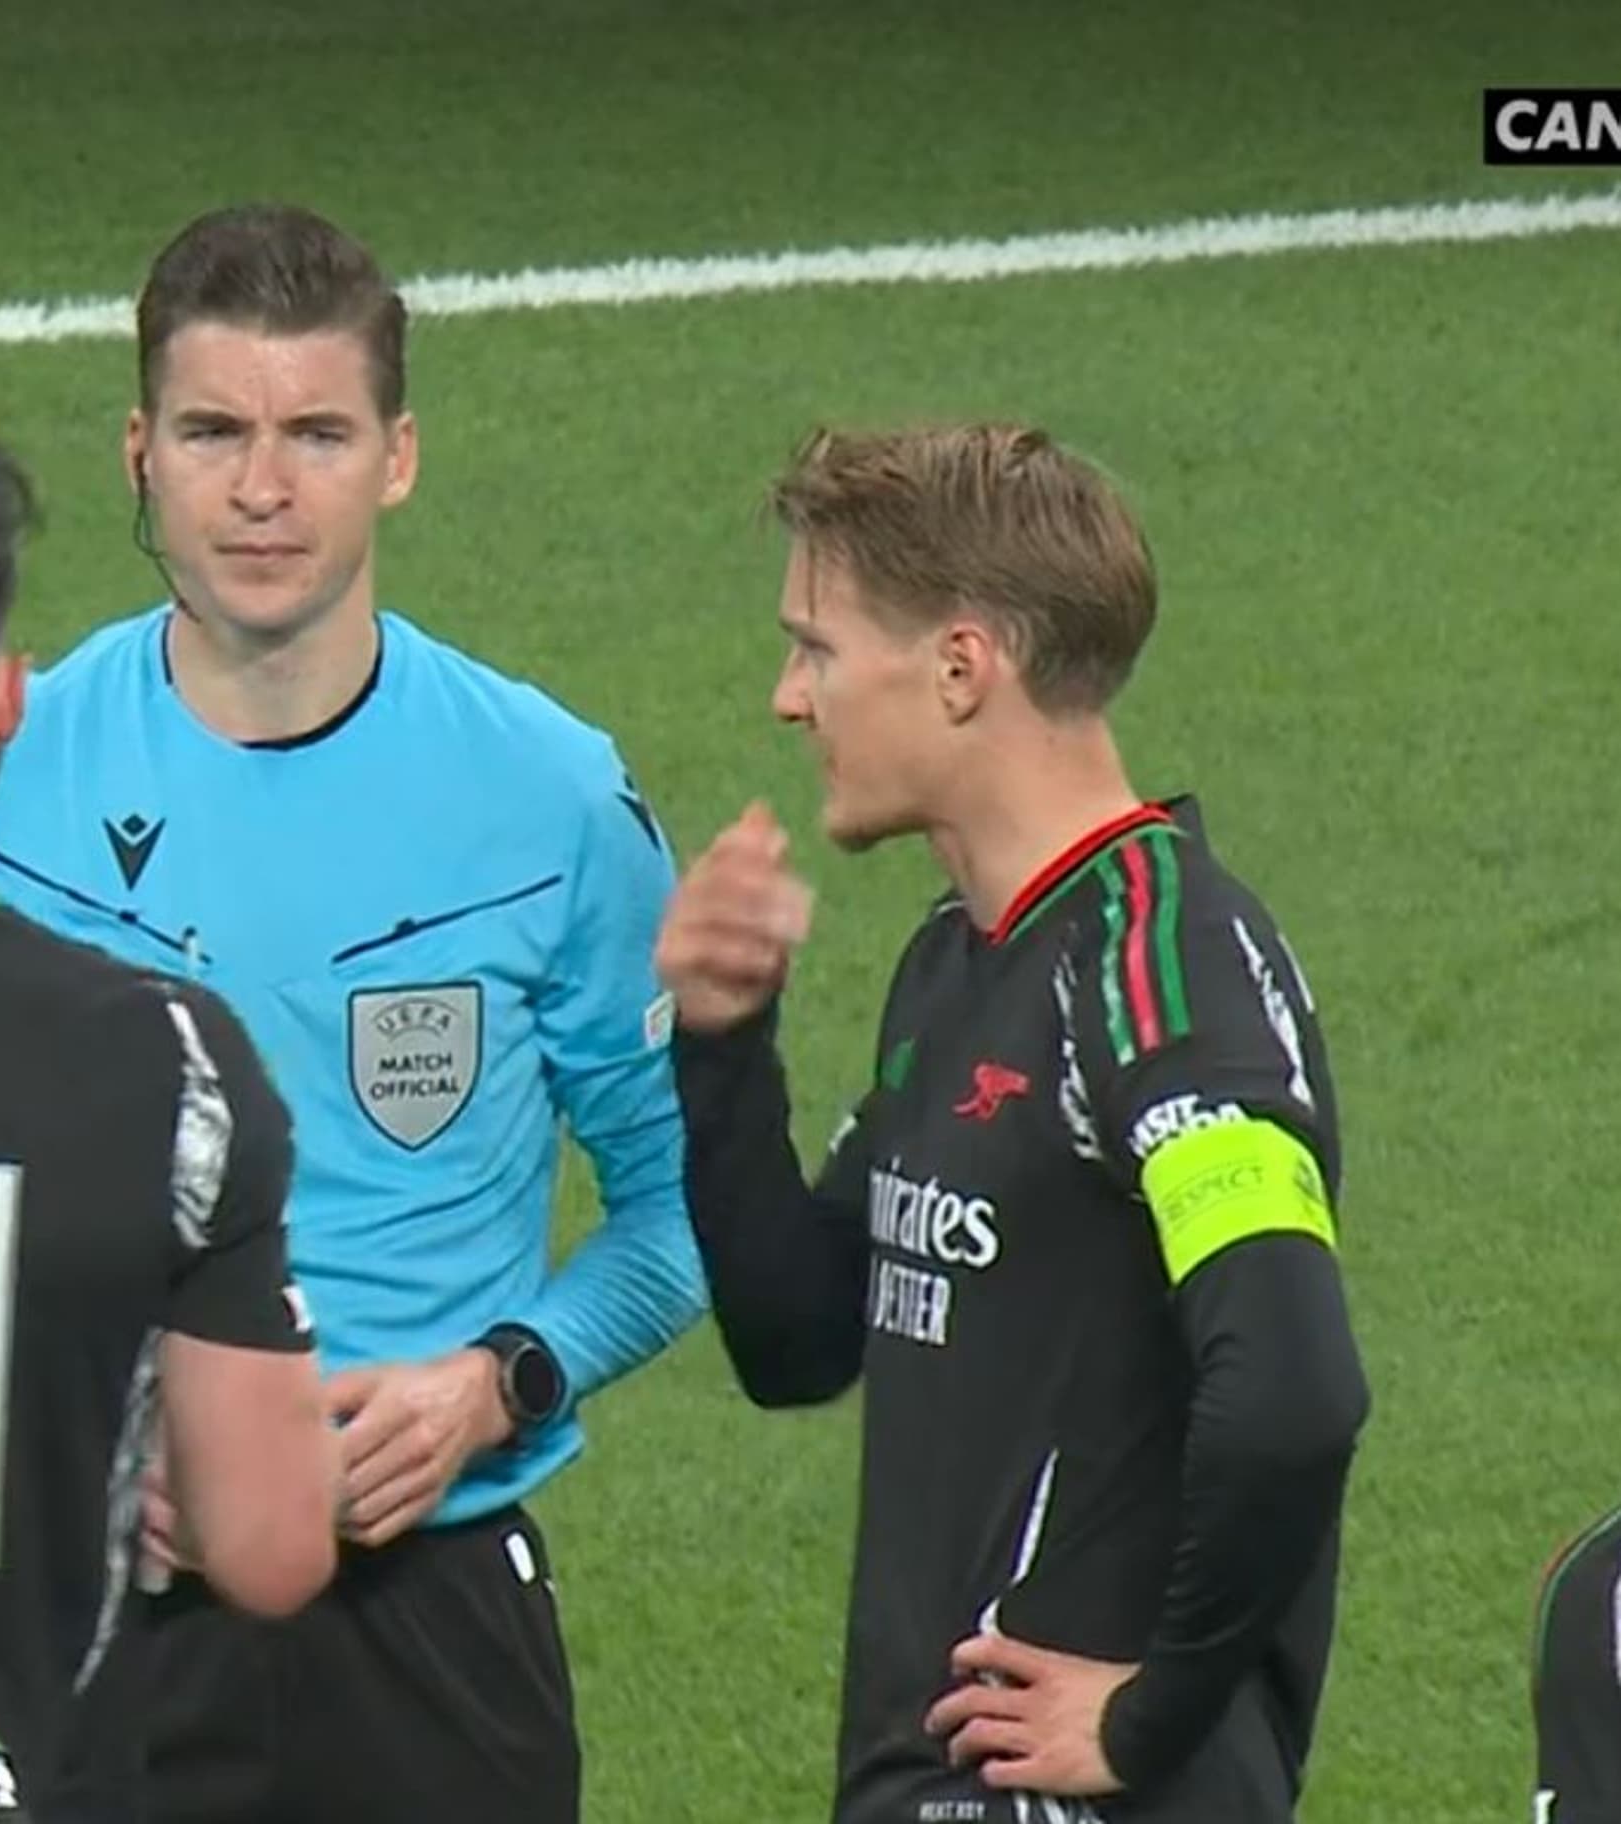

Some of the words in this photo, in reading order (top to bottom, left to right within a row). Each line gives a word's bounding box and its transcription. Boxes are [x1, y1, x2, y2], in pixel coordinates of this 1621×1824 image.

[376, 1005, 451, 1035] UEFA
[378, 1052, 452, 1073] MATCH
[369, 1076, 458, 1101] OFFICIAL
